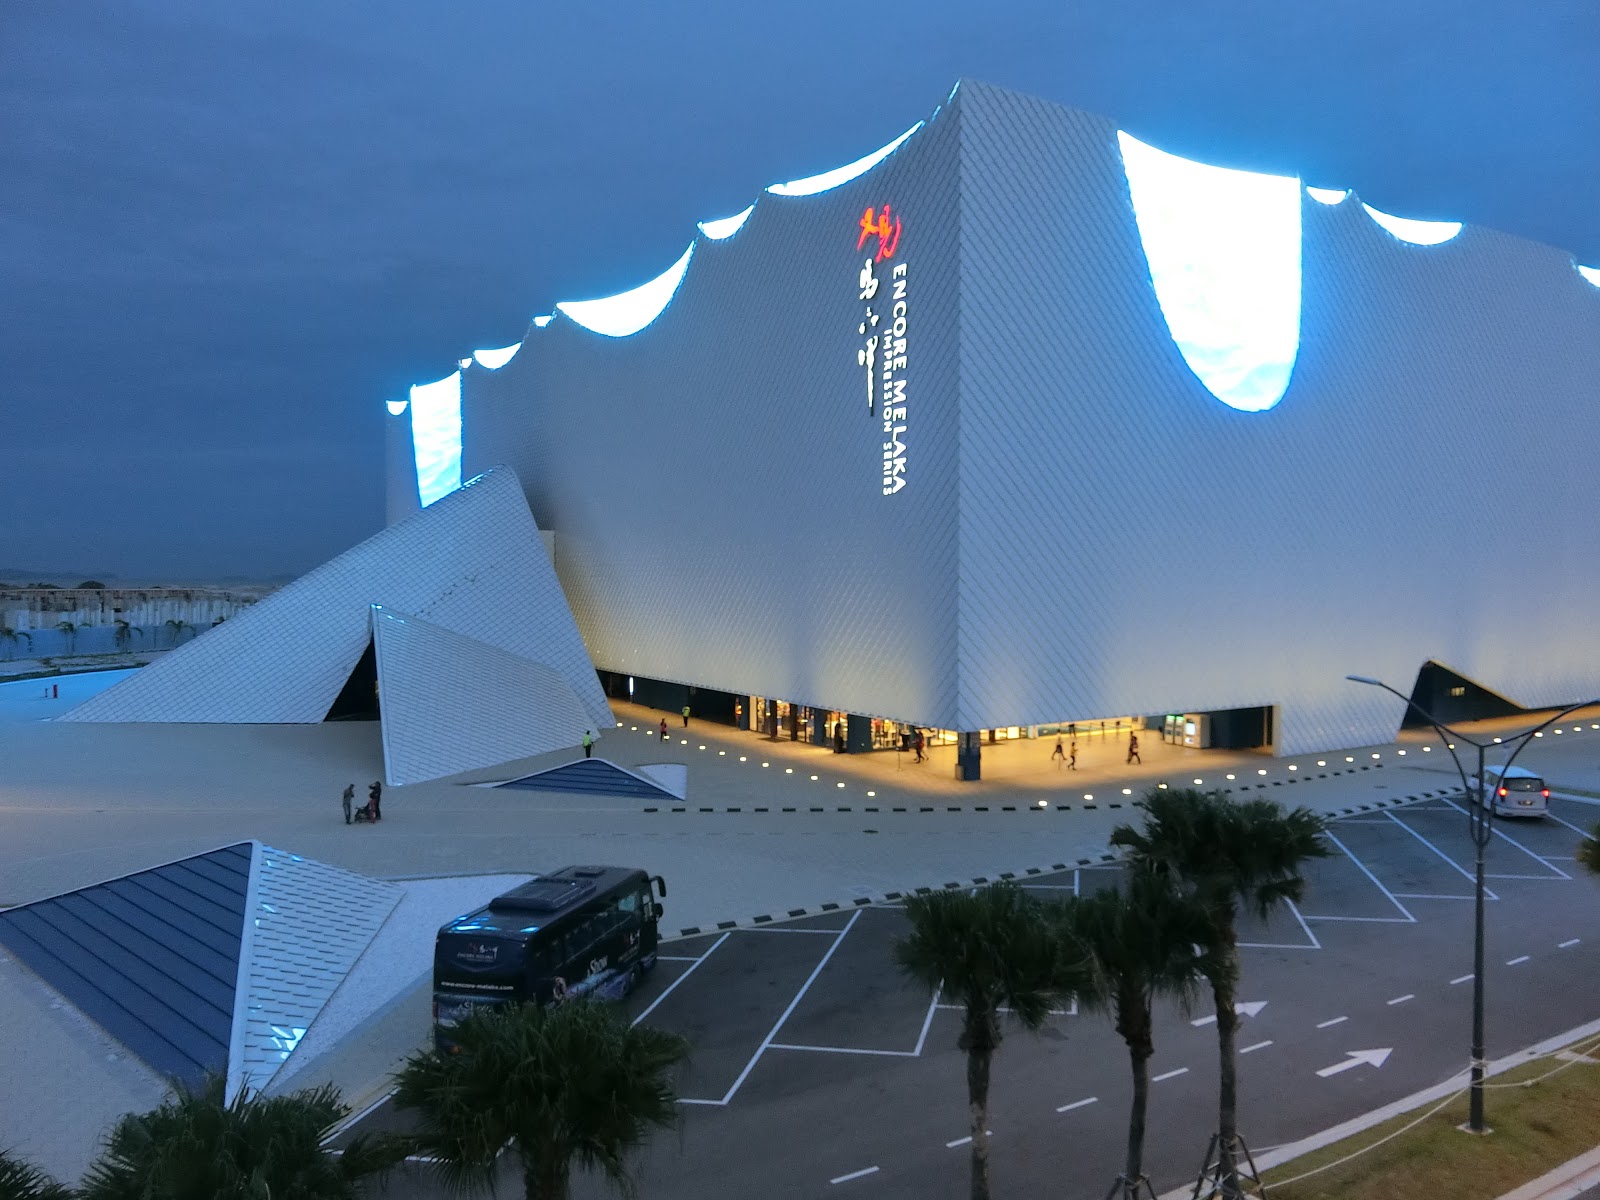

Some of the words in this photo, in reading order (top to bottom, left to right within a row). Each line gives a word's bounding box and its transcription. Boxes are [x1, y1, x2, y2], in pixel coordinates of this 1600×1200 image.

[893, 263, 907, 371] ENCORE
[883, 328, 893, 433] IMPRESSION
[882, 442, 893, 496] SERIES
[892, 379, 907, 494] MELAKA
